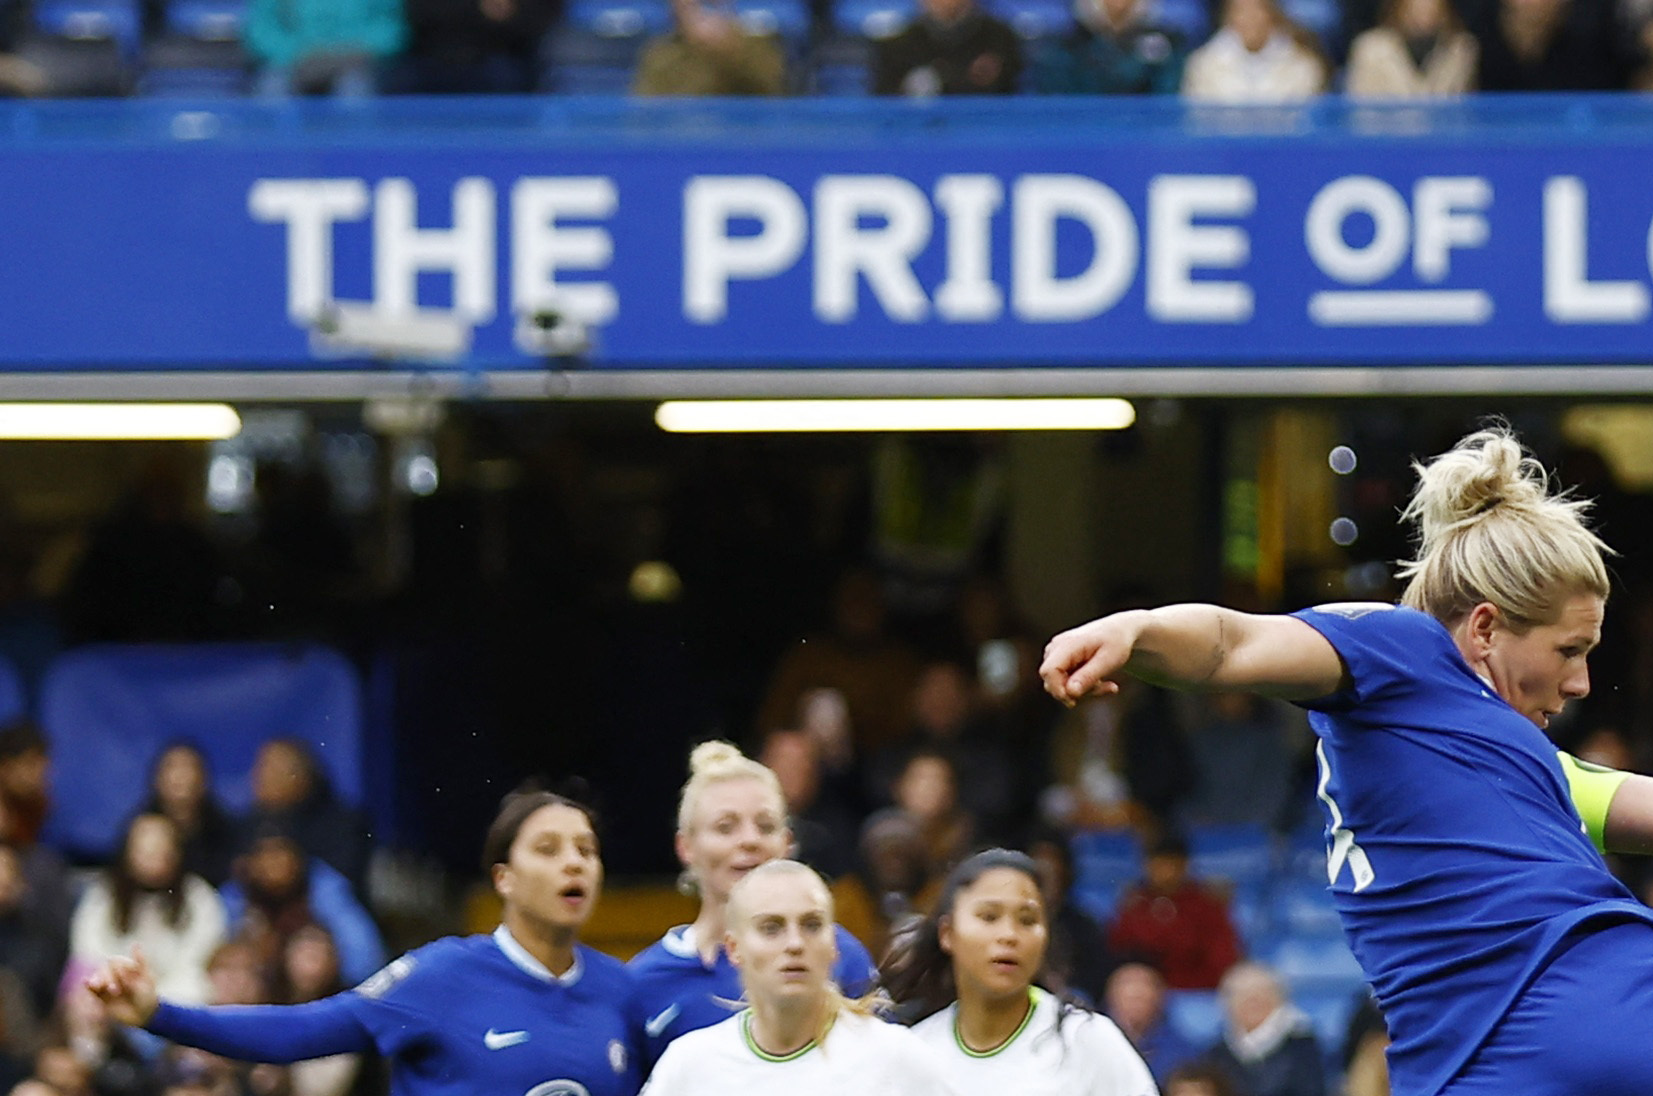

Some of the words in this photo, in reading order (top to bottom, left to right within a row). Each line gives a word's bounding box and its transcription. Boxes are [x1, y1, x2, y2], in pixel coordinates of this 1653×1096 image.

[247, 174, 621, 327] THE
[681, 172, 1258, 326] PRIDE
[1304, 174, 1496, 286] OF
